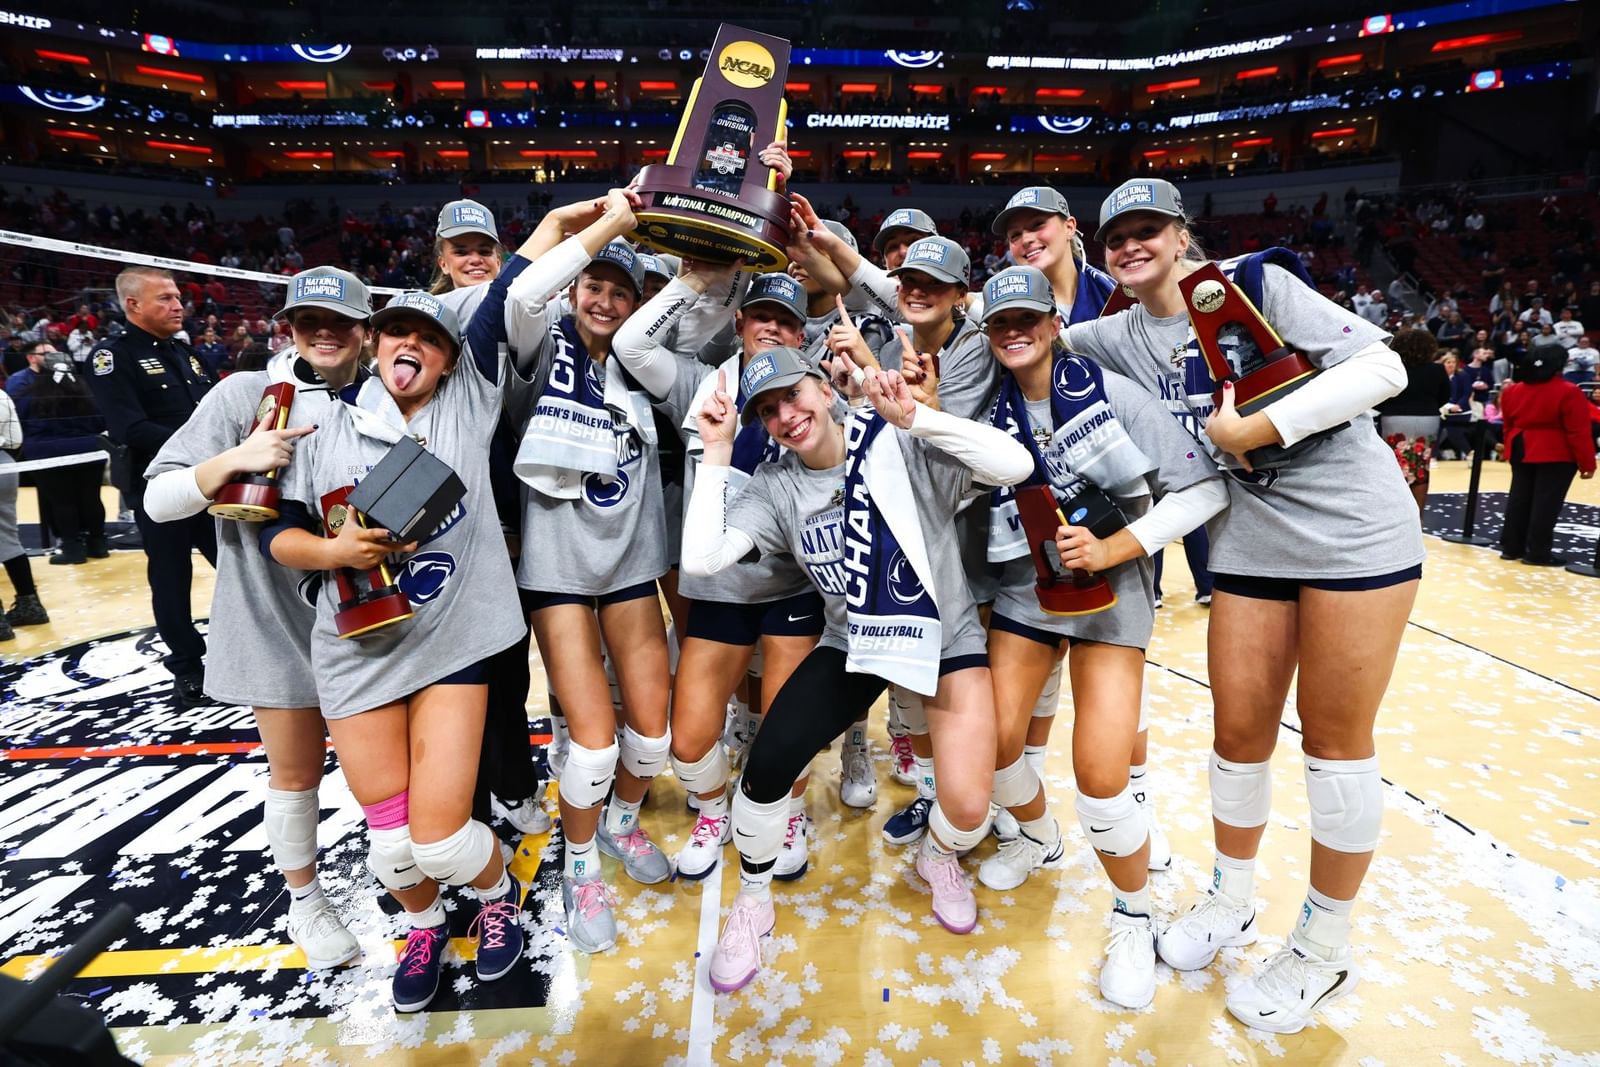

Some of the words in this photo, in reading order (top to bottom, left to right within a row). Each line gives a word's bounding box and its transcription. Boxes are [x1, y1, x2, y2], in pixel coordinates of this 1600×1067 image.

[0, 11, 51, 29] SHIP
[1155, 35, 1286, 67] CHAMPIONSHIP
[721, 56, 771, 82] NCAA
[717, 118, 749, 132] DIVISION
[727, 114, 746, 123] 2024
[807, 113, 949, 130] CHAMPIONSHIP
[1117, 185, 1151, 200] NATIONAL
[1116, 193, 1152, 209] CHAMPIONS
[662, 194, 706, 212] NATIONAL
[707, 204, 757, 227] CHAMPION
[607, 244, 635, 262] NATIONAL
[674, 233, 714, 248] NATIONAL
[715, 242, 760, 258] CHAMPION
[305, 277, 341, 287] NATIONAL
[998, 275, 1028, 287] NATIONAL
[303, 286, 341, 297] CHAMPIONS
[767, 285, 796, 300] CHAMPIONS
[997, 284, 1028, 296] CHAMPIONS
[406, 295, 440, 309] NATIONAL
[1197, 288, 1224, 309] NCAA
[645, 315, 668, 338] STATE
[746, 357, 771, 378] NATIONAL
[748, 365, 774, 389] CHAMPIONS
[805, 516, 819, 526] NCAA
[820, 511, 843, 523] DIVISION
[861, 625, 924, 639] VOLLEYBALL
